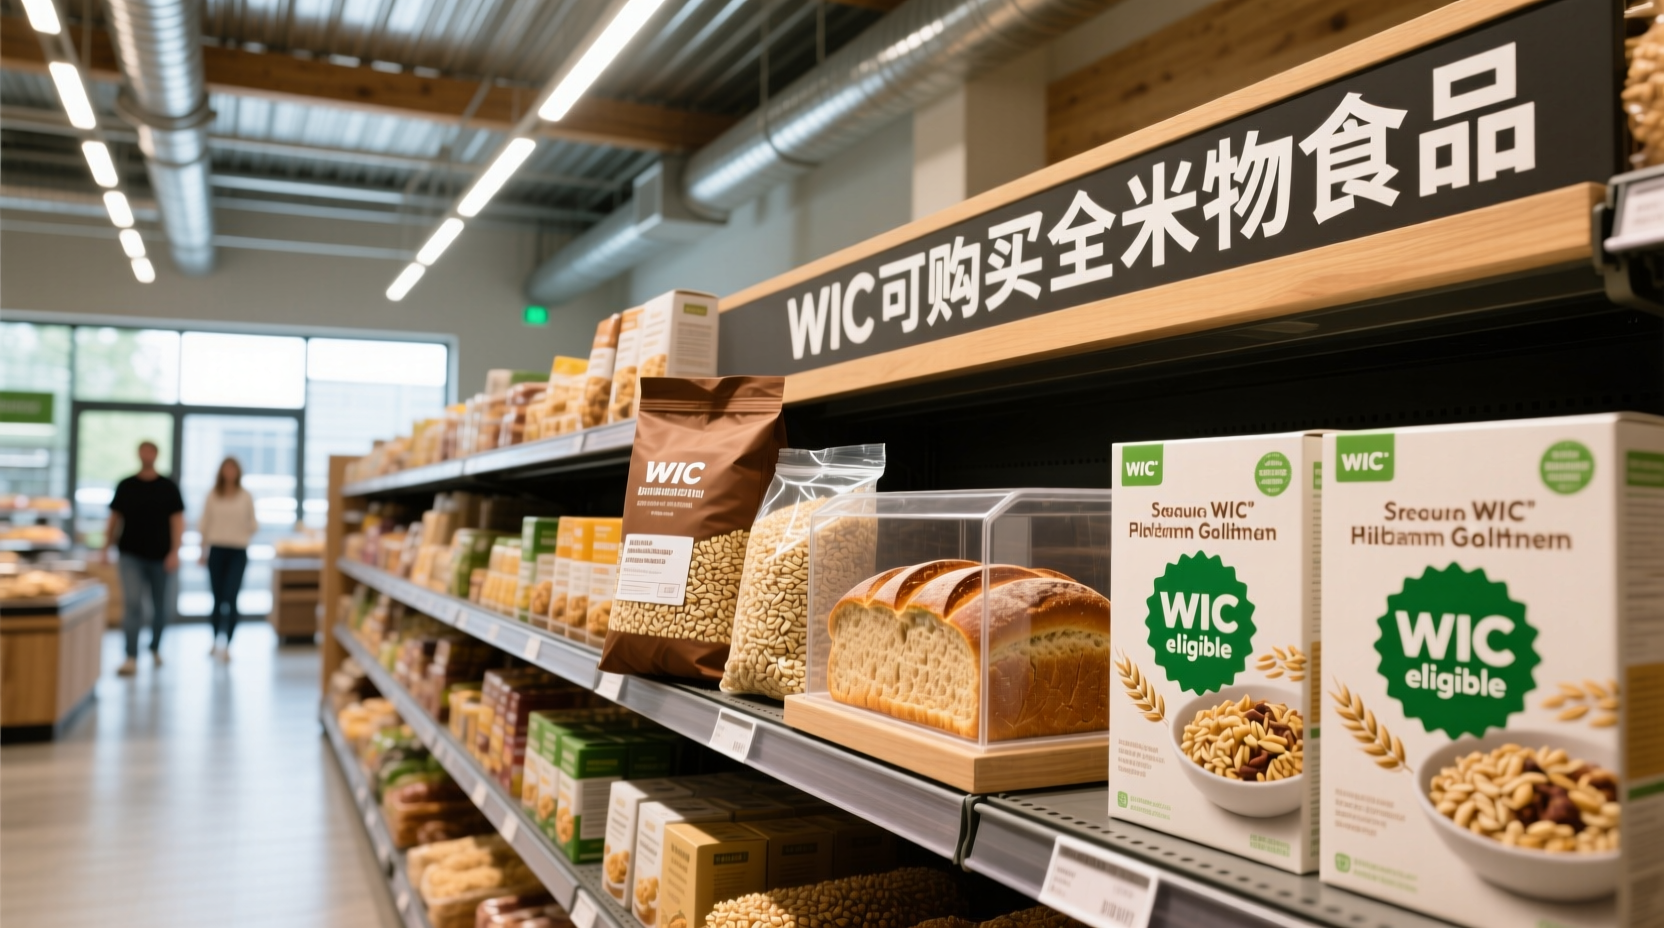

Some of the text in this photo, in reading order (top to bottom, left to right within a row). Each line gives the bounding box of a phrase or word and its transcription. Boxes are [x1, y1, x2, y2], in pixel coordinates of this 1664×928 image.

[646, 461, 706, 485] WIC
[1160, 591, 1239, 634] WIC
[1166, 633, 1232, 662] eligible
[1395, 610, 1516, 668] WIC
[1405, 662, 1507, 700] eligible
